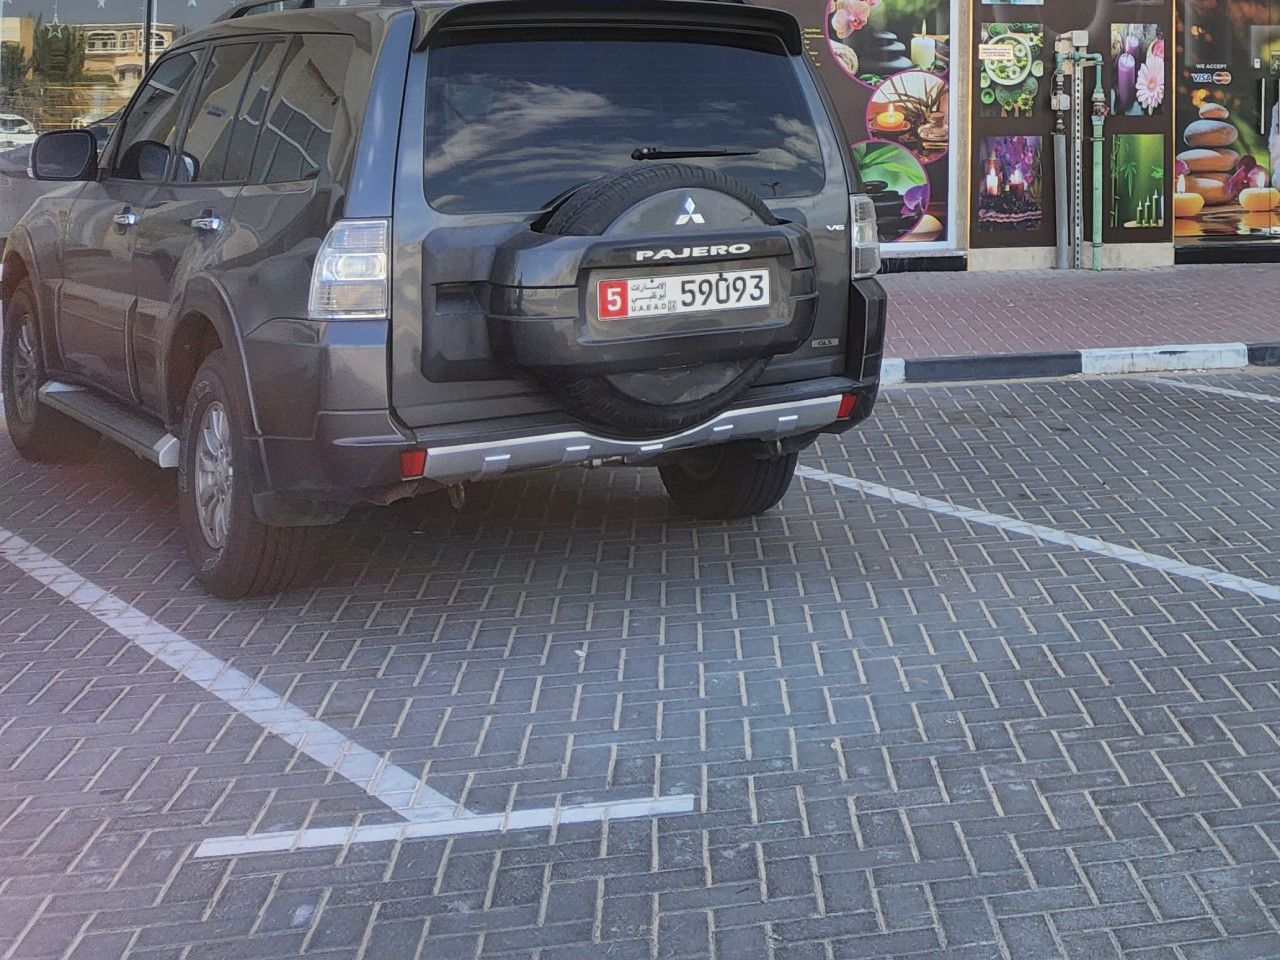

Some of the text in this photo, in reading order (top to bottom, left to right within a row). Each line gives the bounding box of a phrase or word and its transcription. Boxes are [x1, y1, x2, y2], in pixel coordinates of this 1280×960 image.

[1192, 74, 1212, 82] VISA
[635, 243, 751, 261] PAJERO
[607, 275, 764, 311] 5 59093
